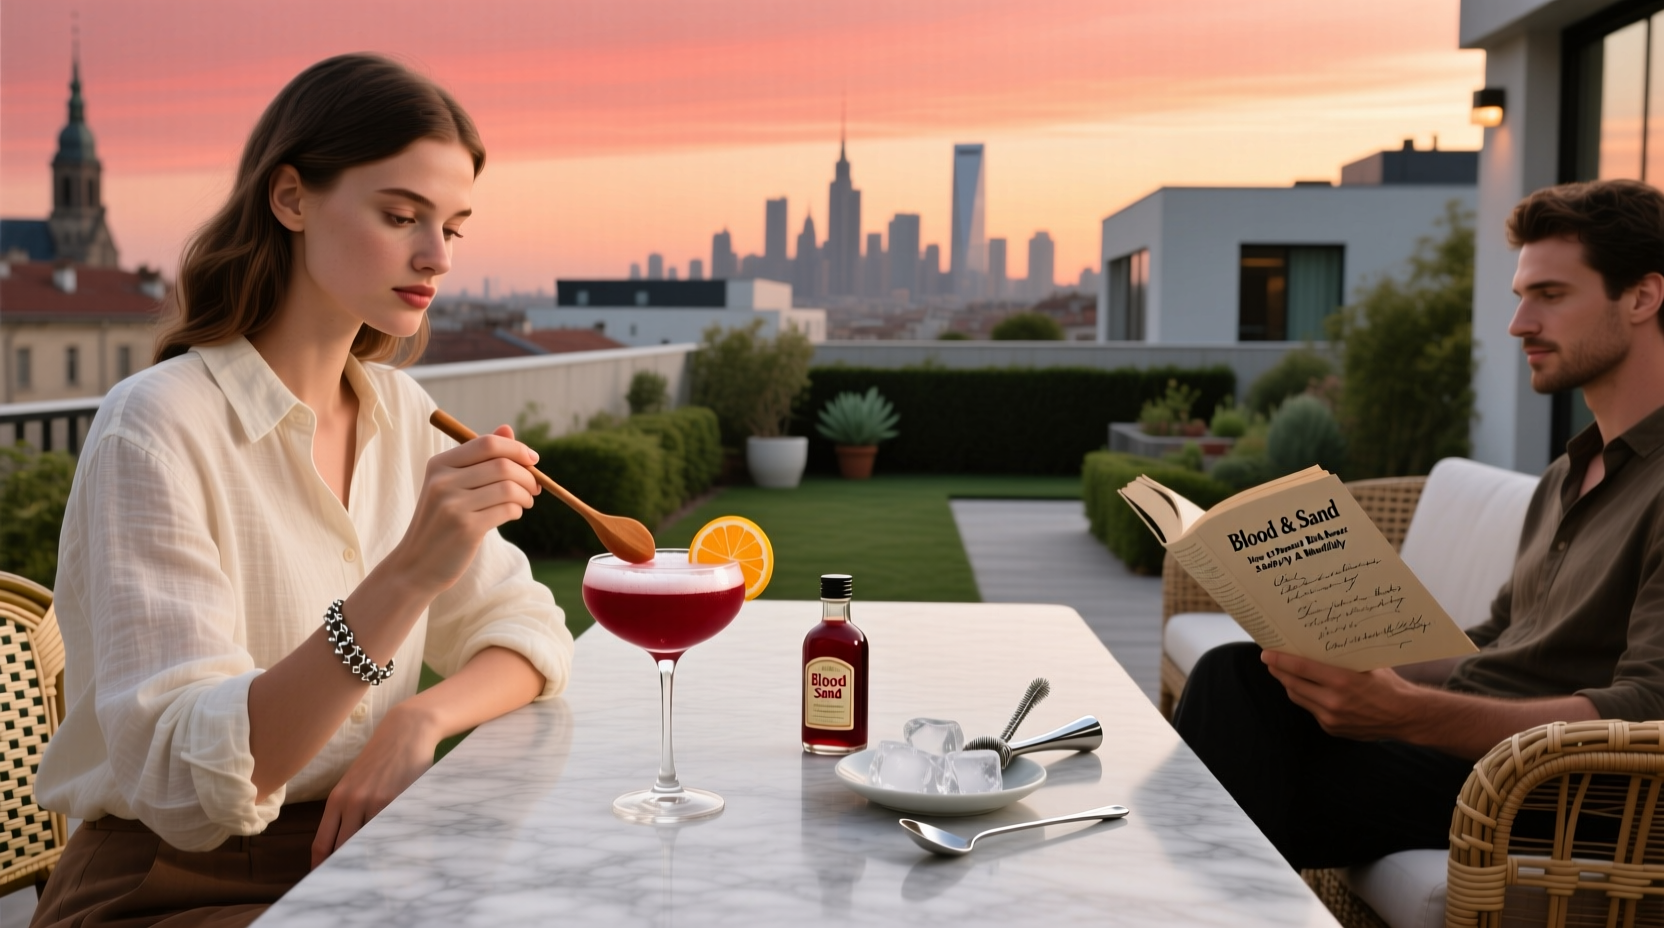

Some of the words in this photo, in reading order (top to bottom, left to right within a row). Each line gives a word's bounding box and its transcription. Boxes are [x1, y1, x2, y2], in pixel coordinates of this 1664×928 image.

[1227, 520, 1278, 551] Blood
[1281, 516, 1297, 534] &
[1295, 499, 1340, 528] Sand
[812, 673, 846, 687] Blood
[814, 688, 842, 699] Sand
